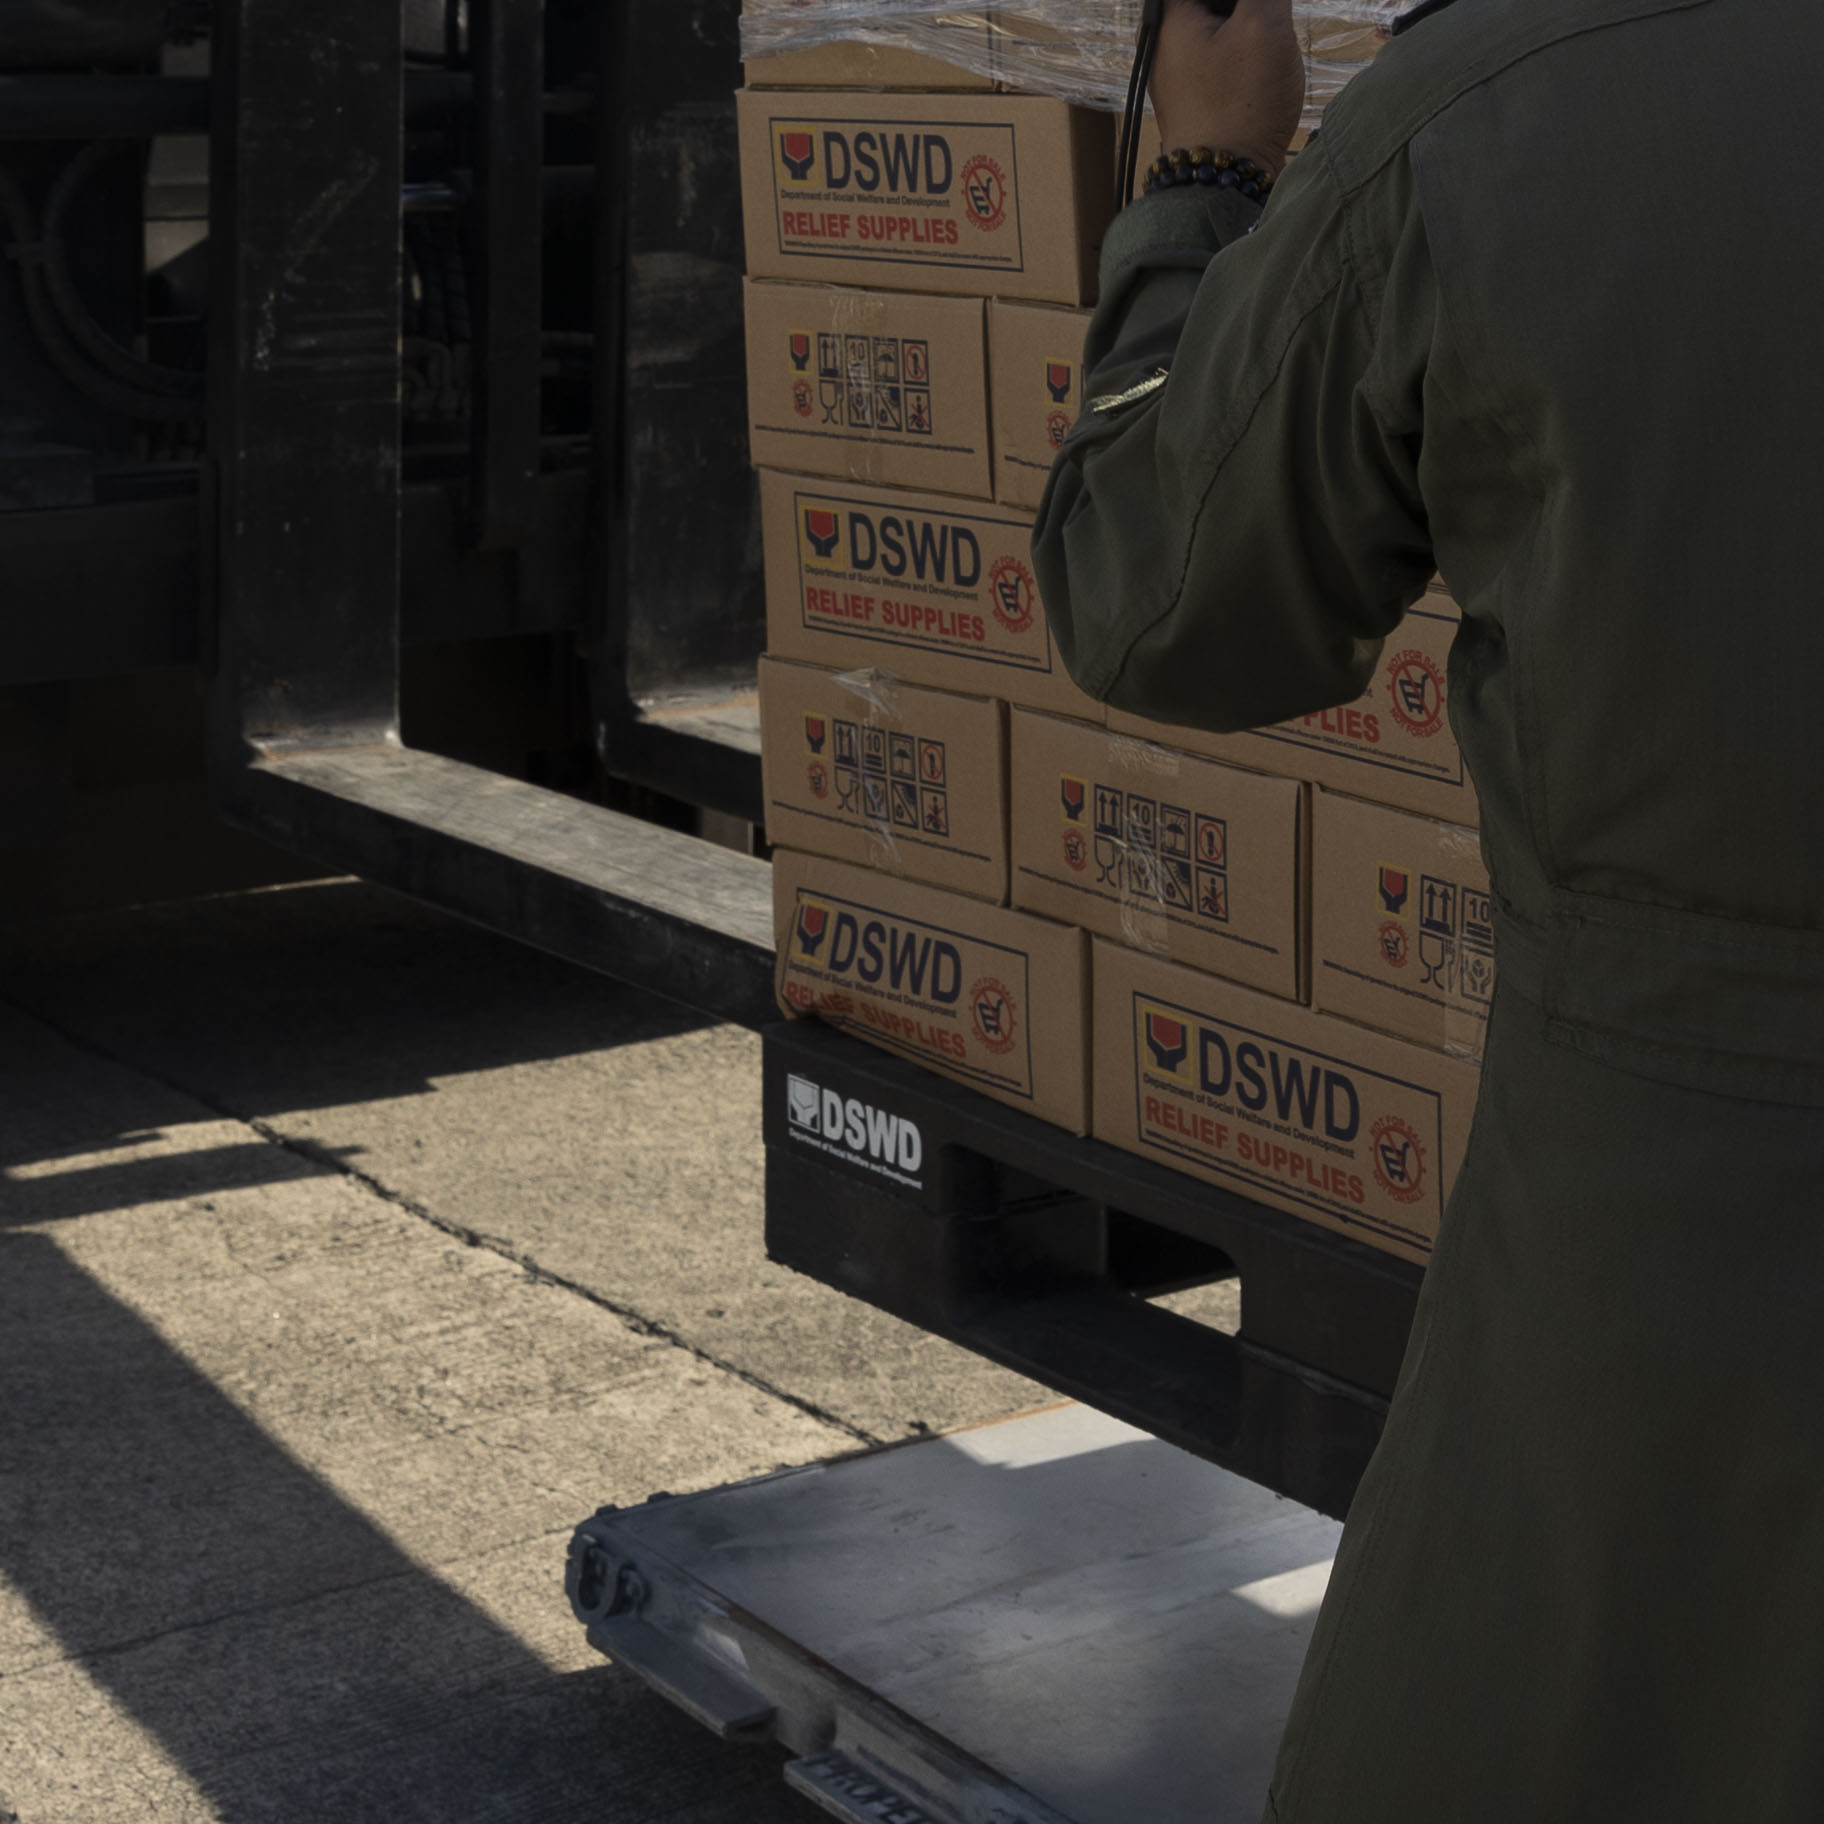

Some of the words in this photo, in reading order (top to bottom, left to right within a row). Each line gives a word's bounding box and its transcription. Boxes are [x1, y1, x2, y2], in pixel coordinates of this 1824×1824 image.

[822, 131, 952, 193] DSWD
[782, 209, 852, 238] RELIEF
[856, 214, 960, 247] SUPPLIES
[849, 512, 982, 587] DSWD
[805, 584, 877, 620] RELIEF
[882, 597, 988, 642] SUPPLIES
[867, 732, 882, 755] 10
[1134, 801, 1152, 825] 10
[1469, 898, 1490, 923] 10
[829, 911, 962, 1004] DSWD
[860, 1002, 967, 1058] SUPPLIES
[1197, 1026, 1359, 1138] DSWD
[822, 1088, 922, 1172] DSWD
[1144, 1094, 1229, 1152] RELIEF
[1235, 1128, 1364, 1206] SUPPLIES
